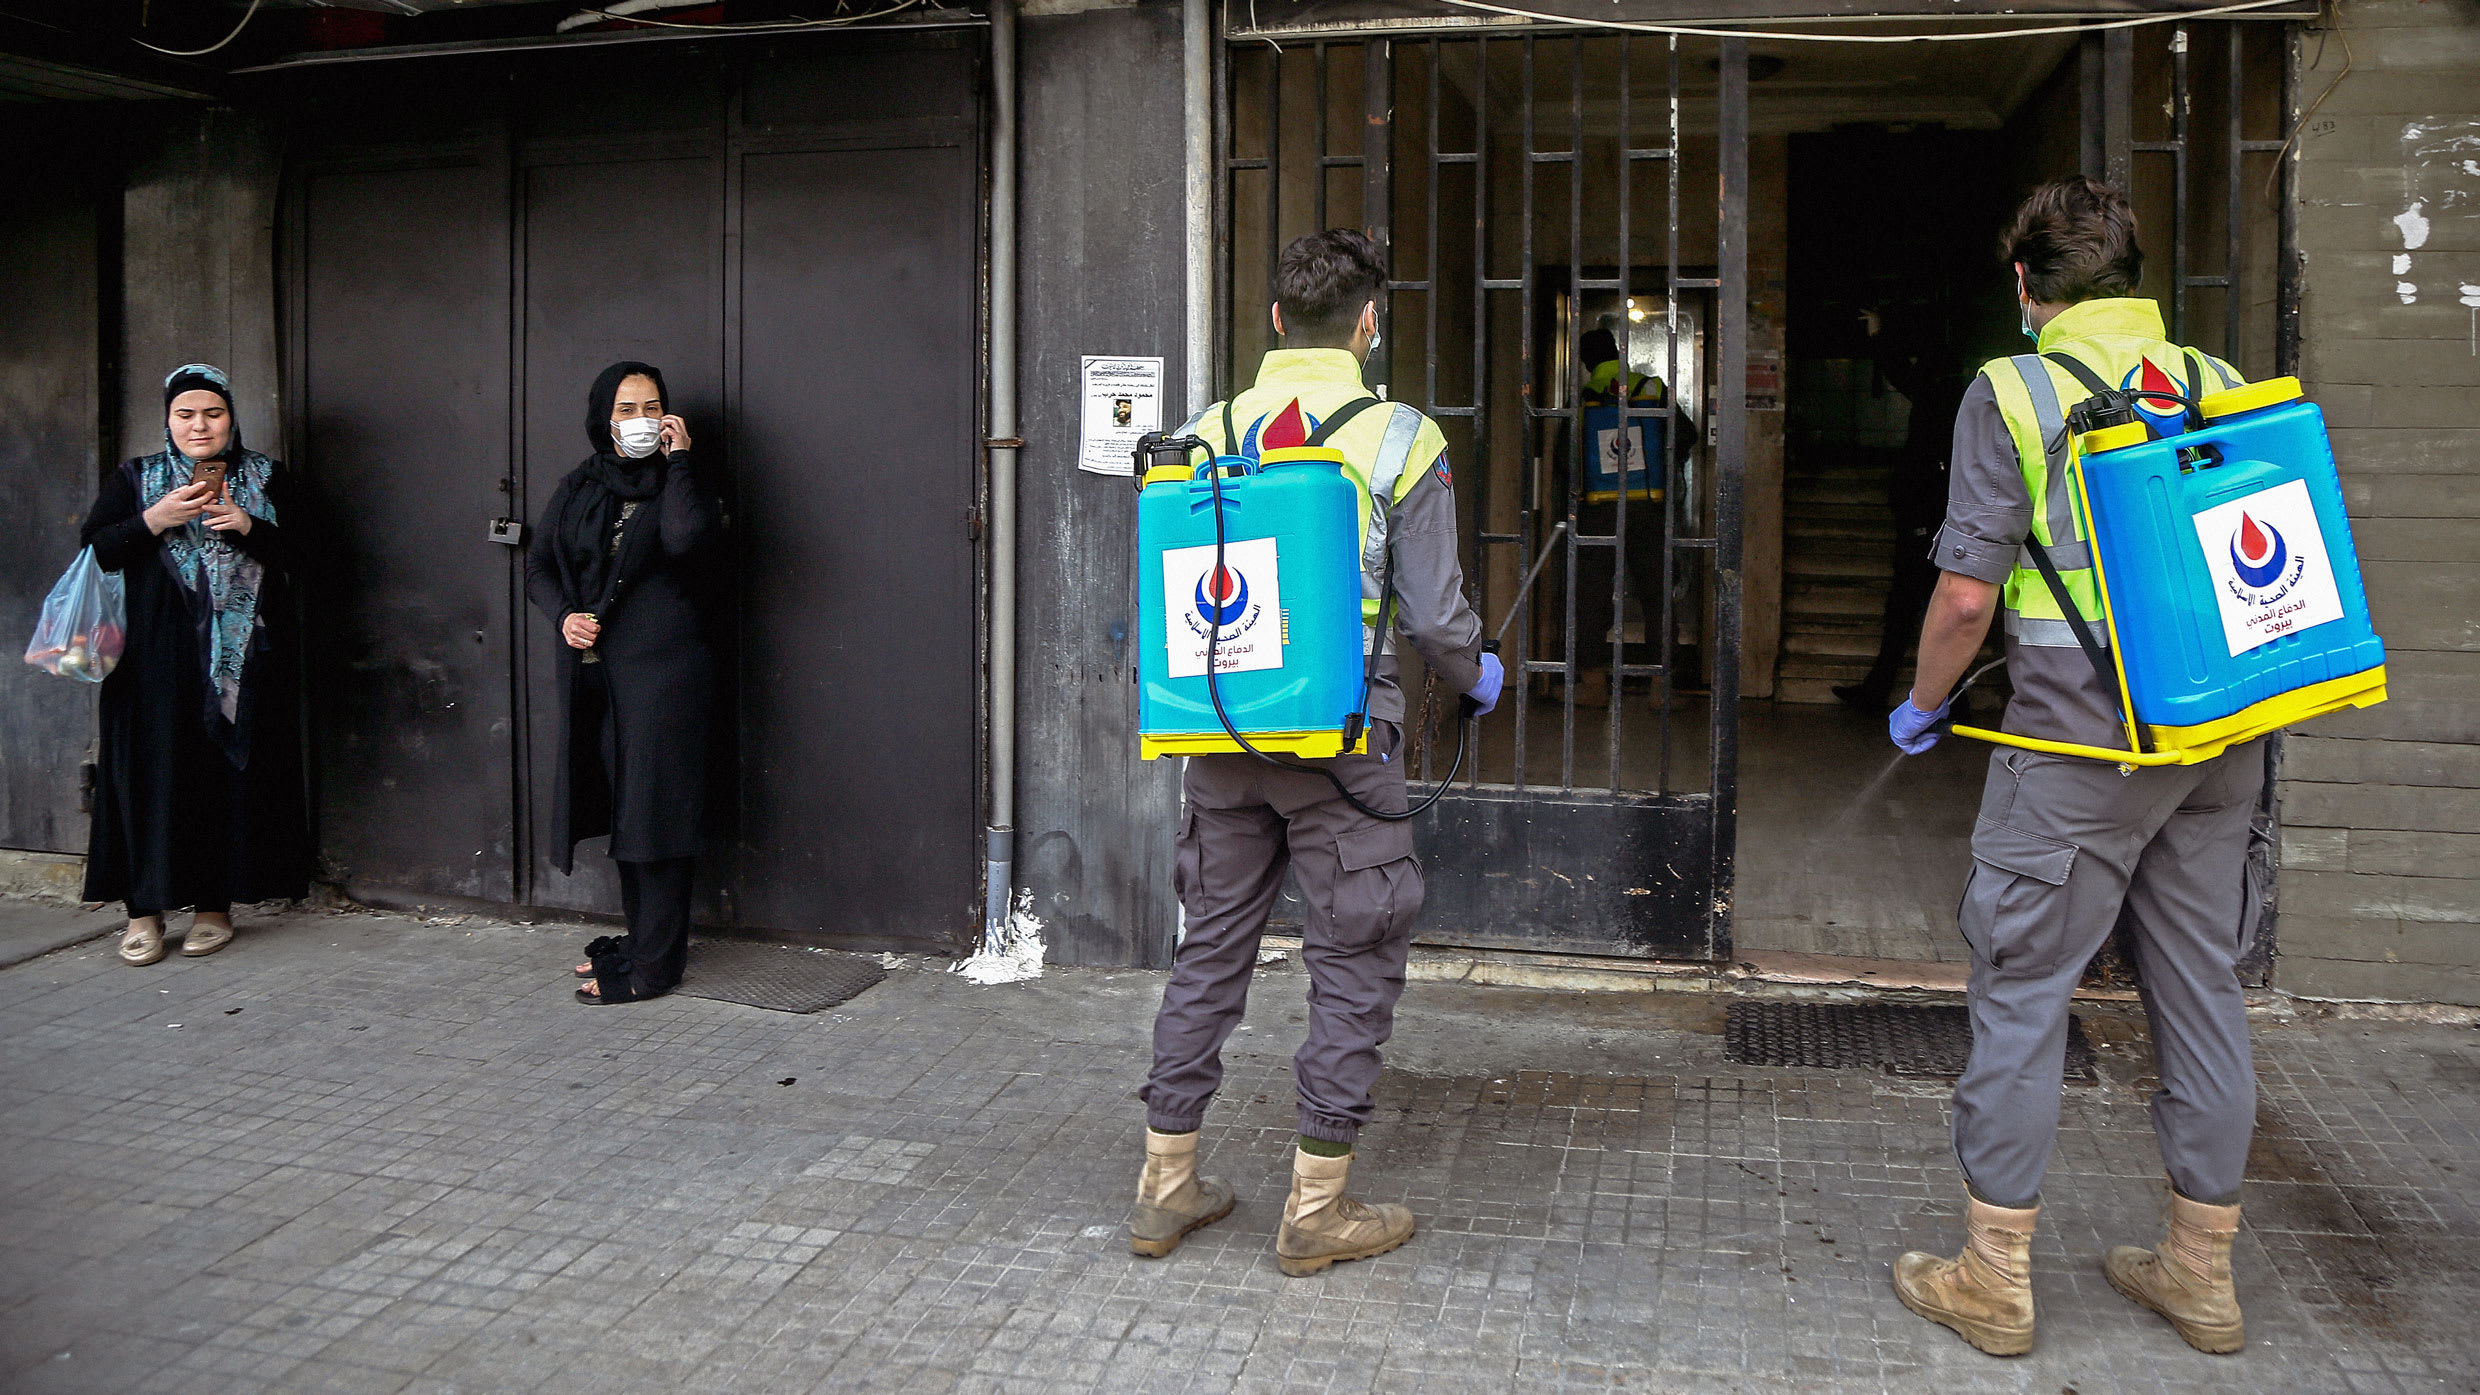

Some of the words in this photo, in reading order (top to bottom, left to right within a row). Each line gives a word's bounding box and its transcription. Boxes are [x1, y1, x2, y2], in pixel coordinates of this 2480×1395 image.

[2259, 585, 2289, 609] الصحية
[2277, 599, 2306, 620] الدفاع
[2246, 608, 2276, 630] المدني
[2264, 618, 2293, 634] بيروت
[1215, 627, 1242, 645] الصحي
[1195, 647, 1226, 660] المني
[1227, 644, 1254, 657] الدفاع
[1213, 658, 1239, 669] بيروت
